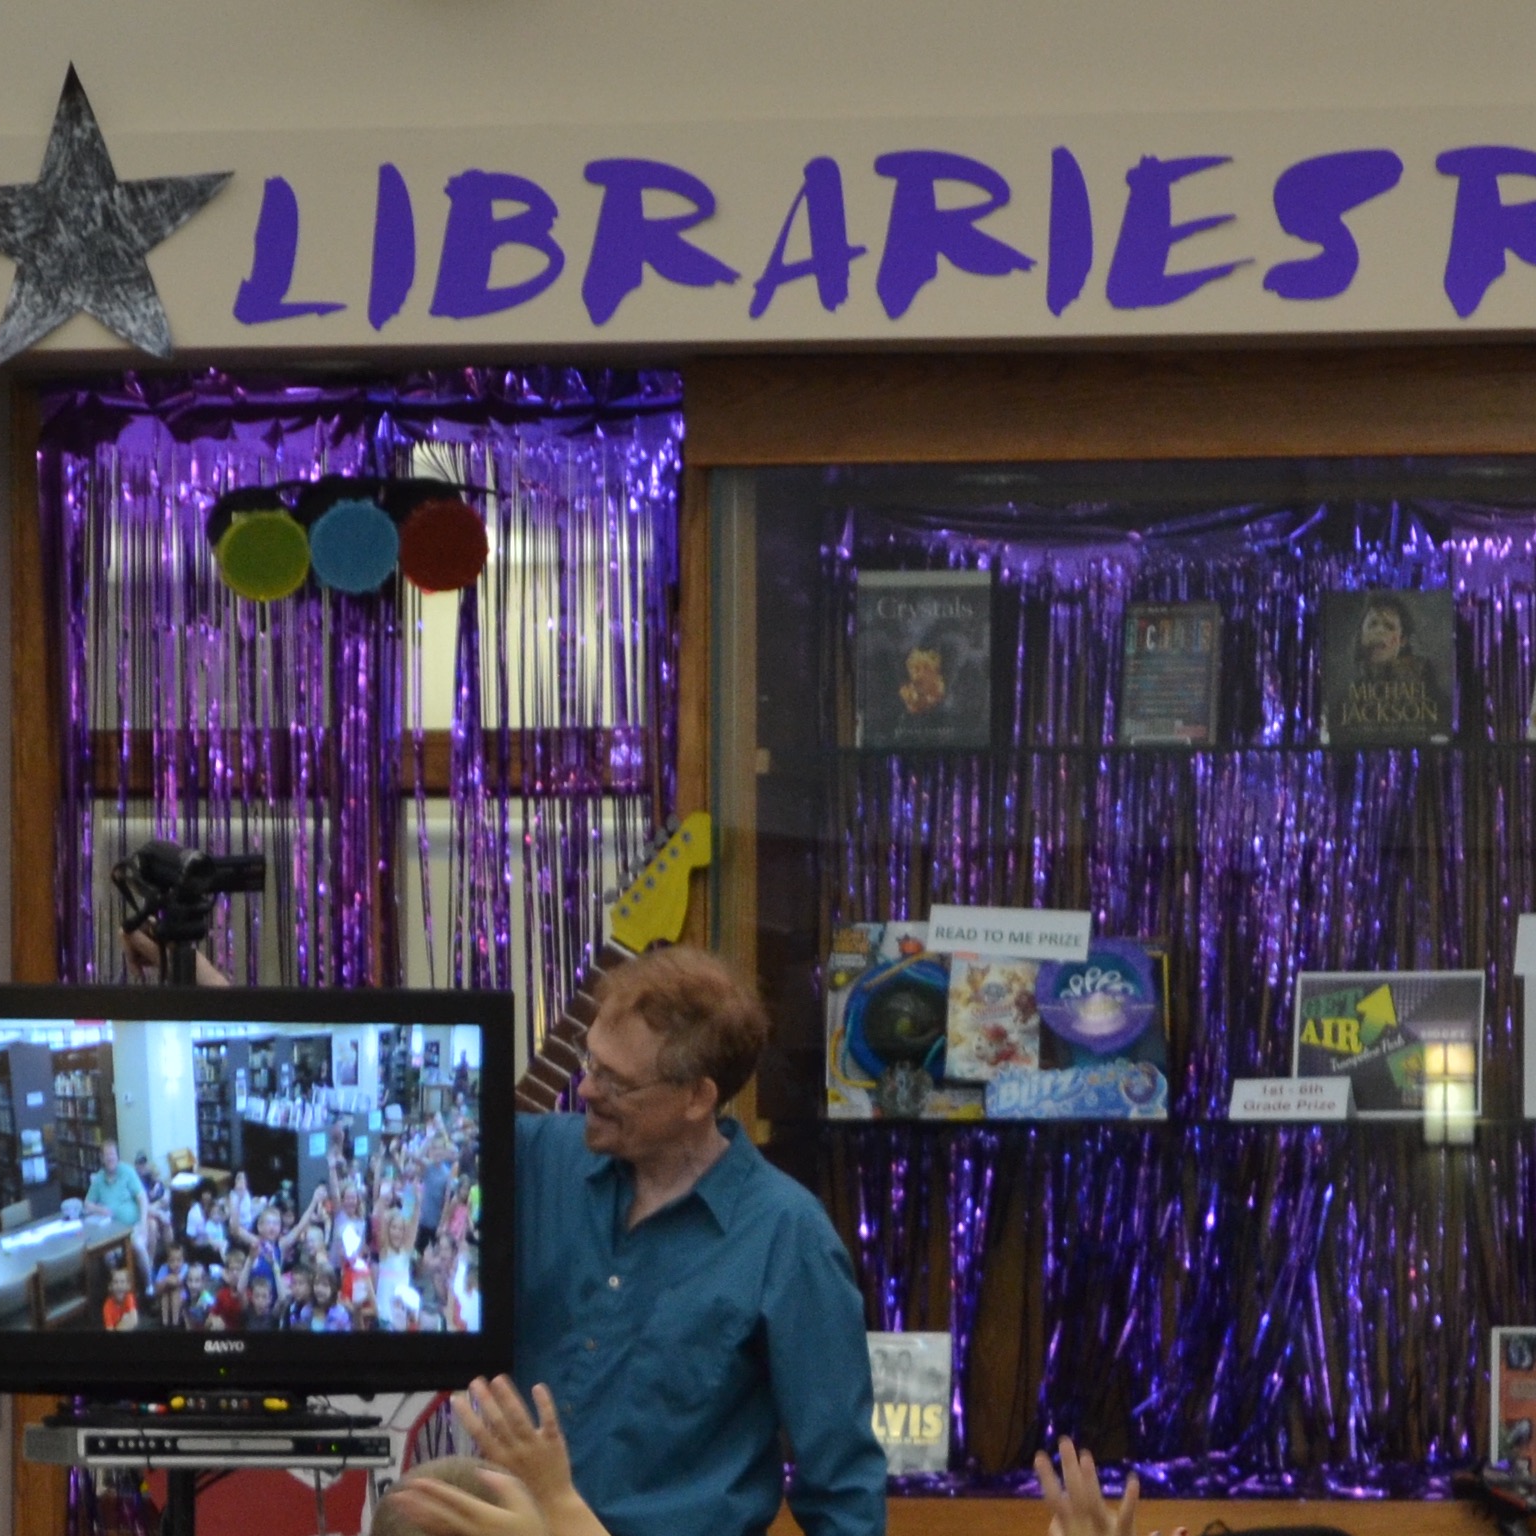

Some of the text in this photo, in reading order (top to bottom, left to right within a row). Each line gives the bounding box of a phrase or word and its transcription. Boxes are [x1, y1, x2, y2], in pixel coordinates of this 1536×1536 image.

[233, 146, 1405, 331] LIBRARIES
[1349, 681, 1426, 700] MICHAEL
[1340, 702, 1438, 725] JACKSON
[935, 925, 1082, 947] READ TO ME PRIZE
[1300, 1018, 1362, 1055] AIR
[1243, 1100, 1337, 1112] Grade Prize
[204, 1340, 244, 1353] SANYO
[871, 1402, 943, 1439] LVIS
